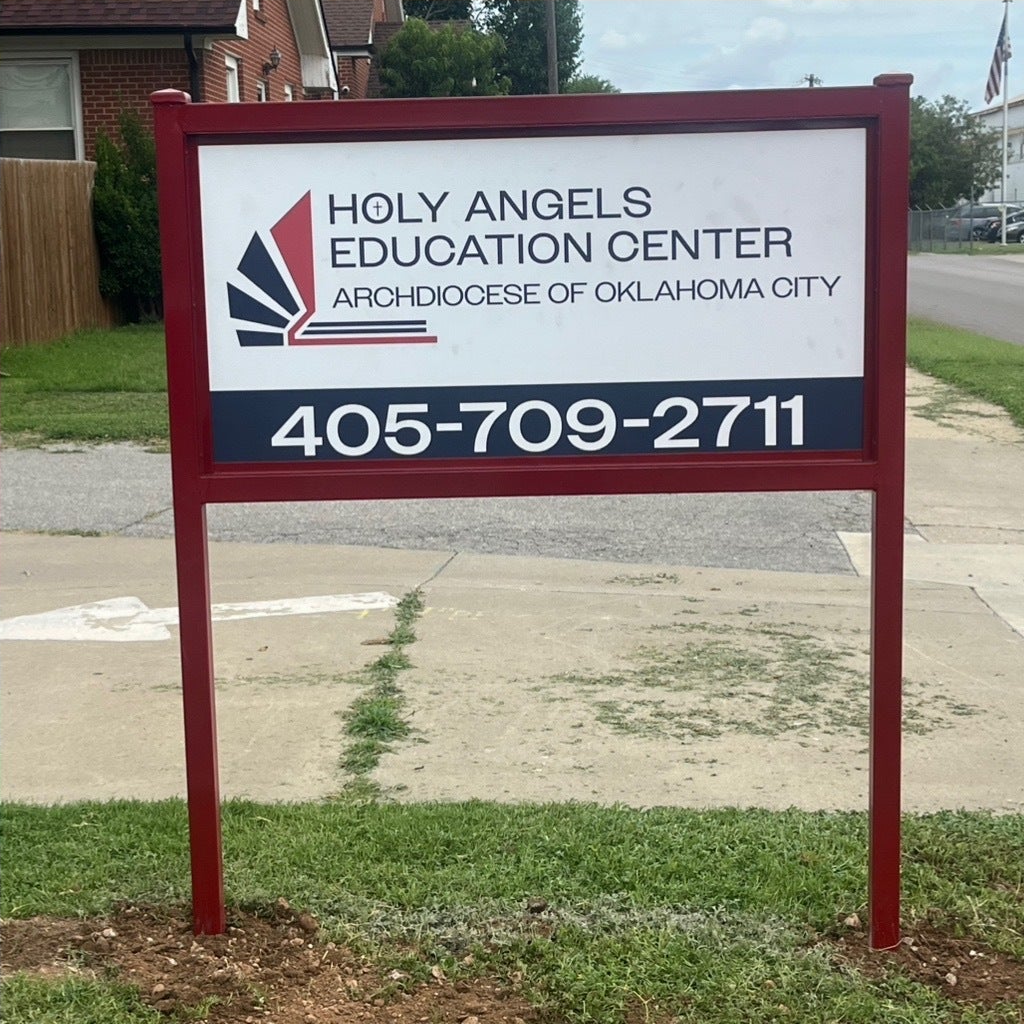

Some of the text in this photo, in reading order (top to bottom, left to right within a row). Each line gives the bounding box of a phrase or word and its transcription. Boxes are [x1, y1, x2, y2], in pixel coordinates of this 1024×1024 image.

[329, 187, 651, 224] HOLY ANGELS
[331, 227, 792, 268] EDUCATION CENTER
[333, 276, 841, 308] ARCHDIOCESE OF OKLAHOMA CITY
[271, 395, 803, 456] 405-709-2711
